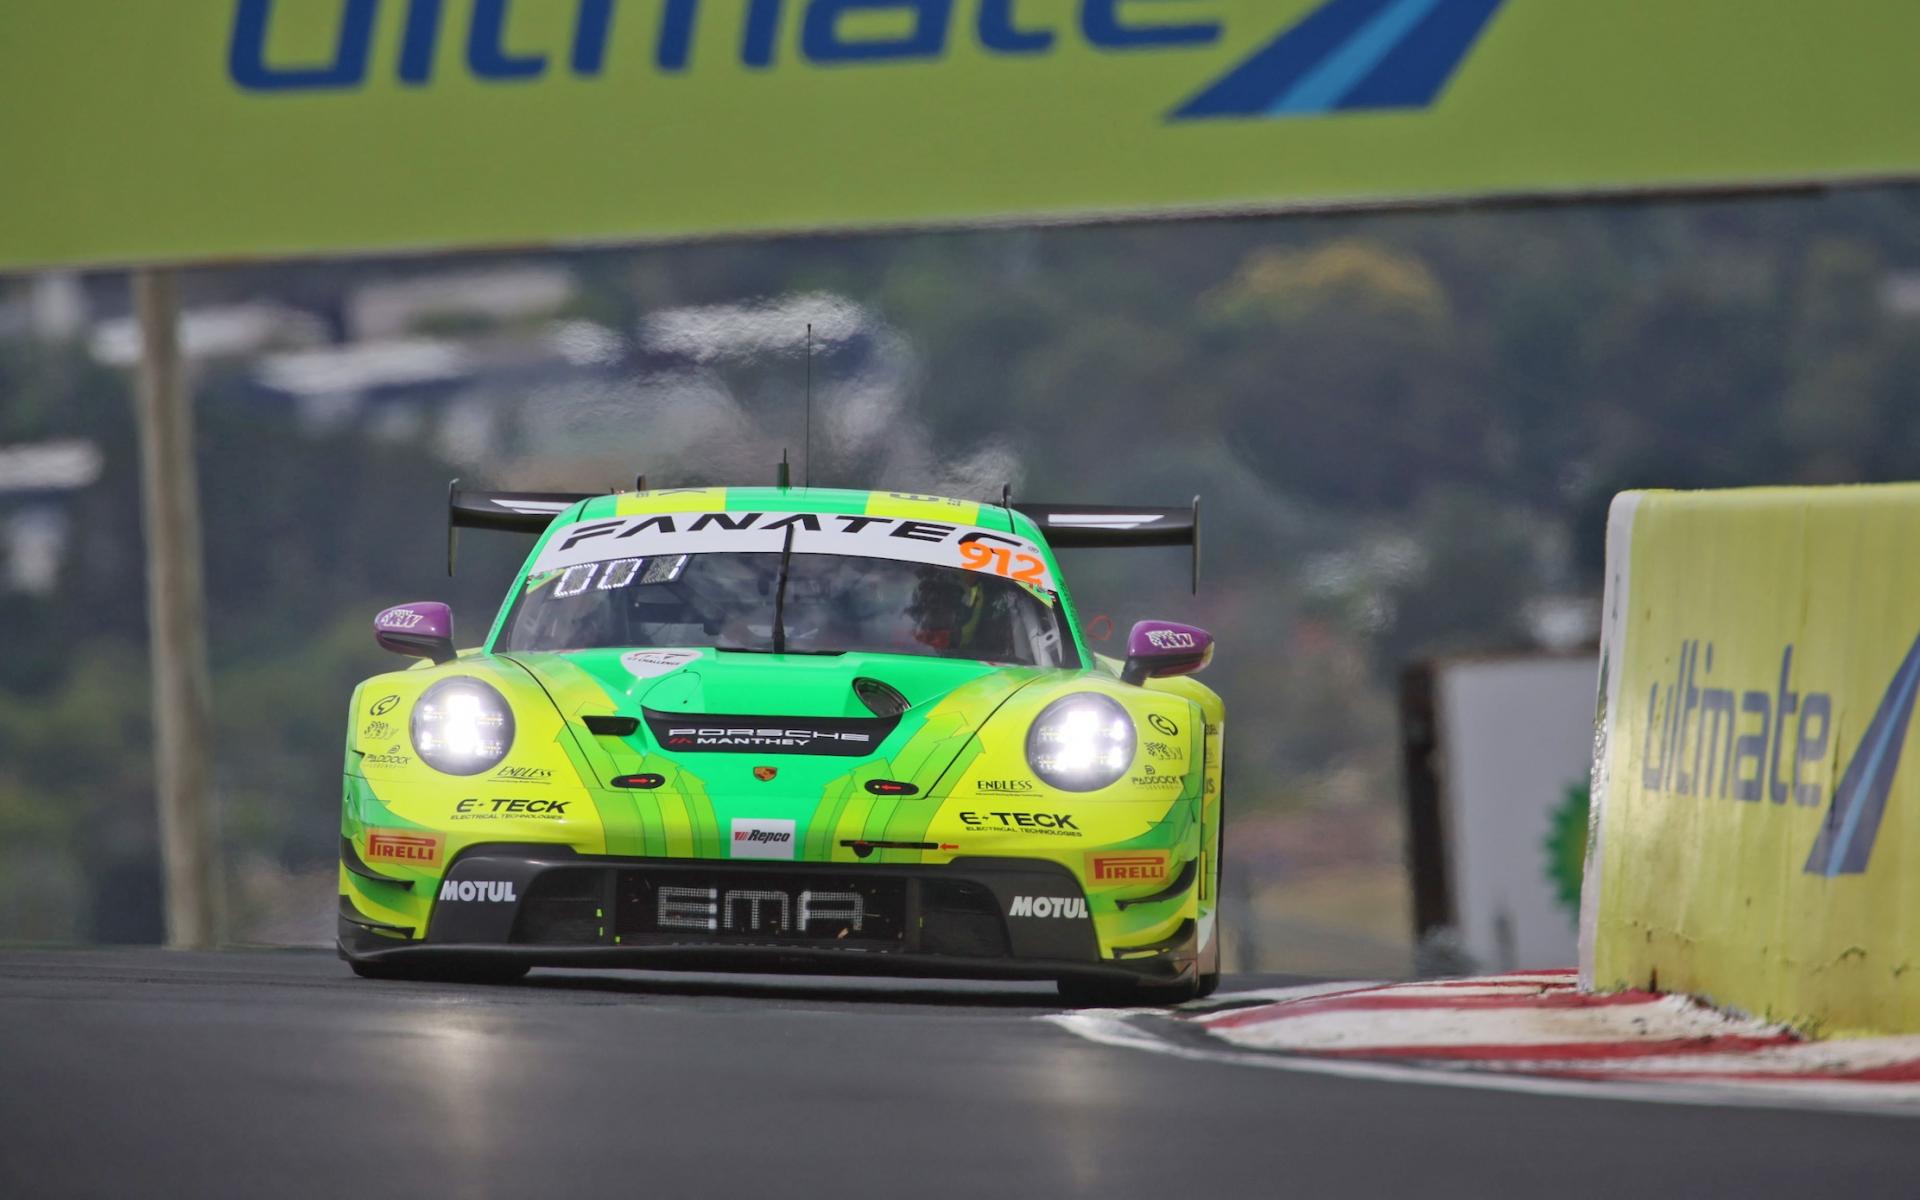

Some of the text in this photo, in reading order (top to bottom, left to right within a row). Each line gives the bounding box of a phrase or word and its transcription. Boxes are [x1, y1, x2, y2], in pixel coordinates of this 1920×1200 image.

[958, 540, 1046, 588] 912
[1642, 638, 1832, 808] ultimate
[668, 729, 870, 741] PORSCHE
[697, 737, 811, 746] MANTHEY
[977, 780, 1033, 790] ENDLESS
[369, 834, 436, 860] PIRELLI
[748, 829, 790, 844] Repco
[1094, 856, 1165, 880] PIRELLI
[439, 880, 517, 903] MOTUL
[1009, 896, 1089, 919] MOTUL
